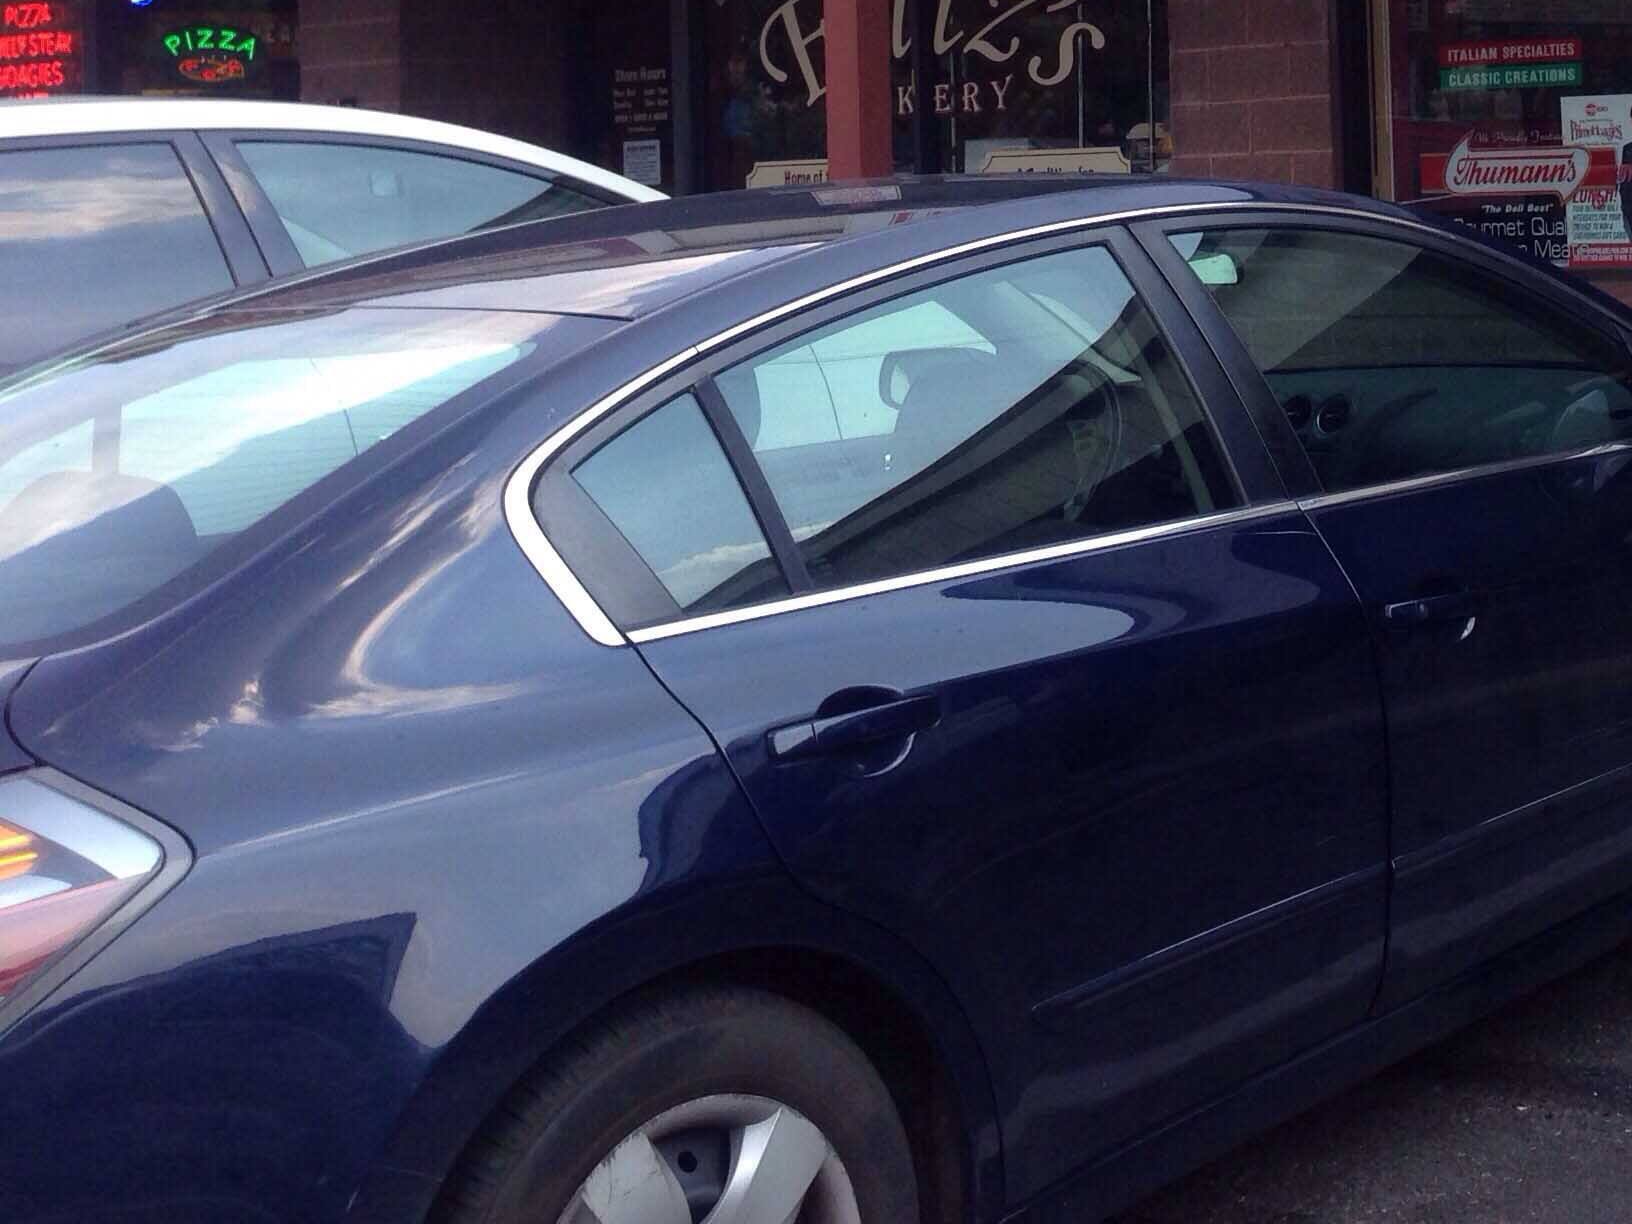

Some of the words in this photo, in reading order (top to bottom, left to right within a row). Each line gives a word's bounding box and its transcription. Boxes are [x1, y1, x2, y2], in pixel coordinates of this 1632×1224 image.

[163, 29, 256, 60] PIZZA
[1447, 46, 1498, 63] ITALIAN
[1502, 42, 1575, 60] SPECIALTIES
[1448, 71, 1501, 87] CLASSIC
[1505, 67, 1576, 85] CREATIONS
[1453, 157, 1578, 185] Thumann's
